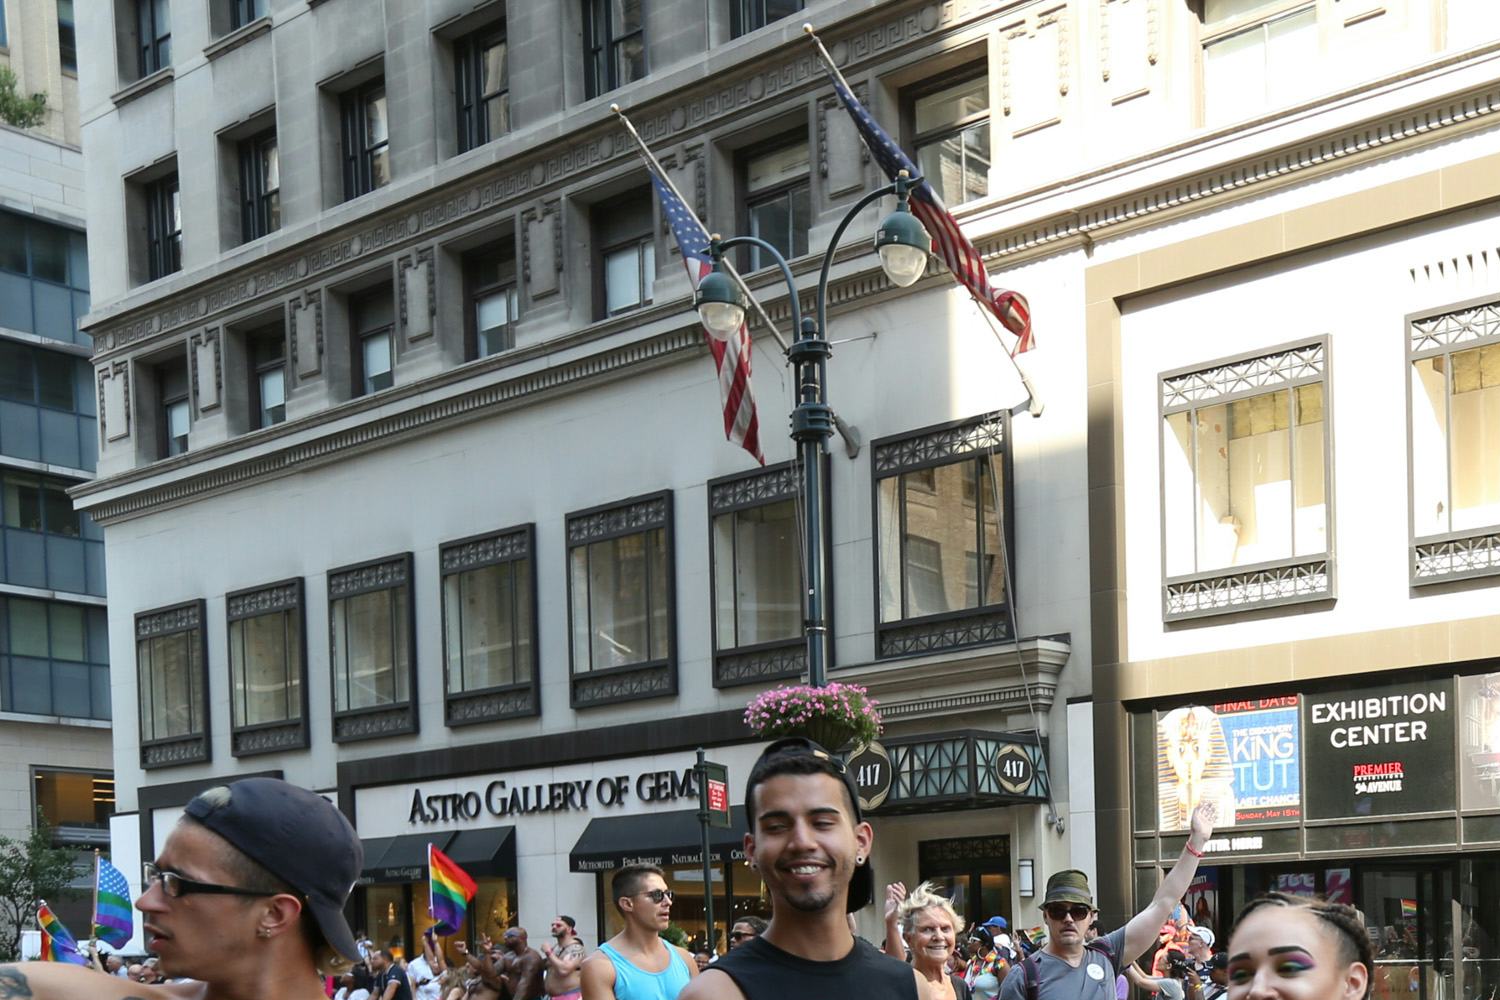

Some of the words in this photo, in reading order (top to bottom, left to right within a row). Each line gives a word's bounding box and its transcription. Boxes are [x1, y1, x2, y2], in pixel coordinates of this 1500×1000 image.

[1311, 691, 1446, 724] EXHIBITION
[1330, 720, 1428, 749] CENTER
[856, 763, 881, 787] 417
[1003, 759, 1024, 778] 417
[1232, 758, 1295, 792] TUT
[1353, 761, 1403, 776] PREMIER
[1366, 780, 1402, 793] AVENUE
[408, 788, 482, 824] ASTRO
[485, 780, 593, 817] GALLERY
[596, 775, 630, 807] OF
[1266, 808, 1281, 818] MAY
[1202, 838, 1231, 852] NTER
[671, 853, 699, 865] NATURAL
